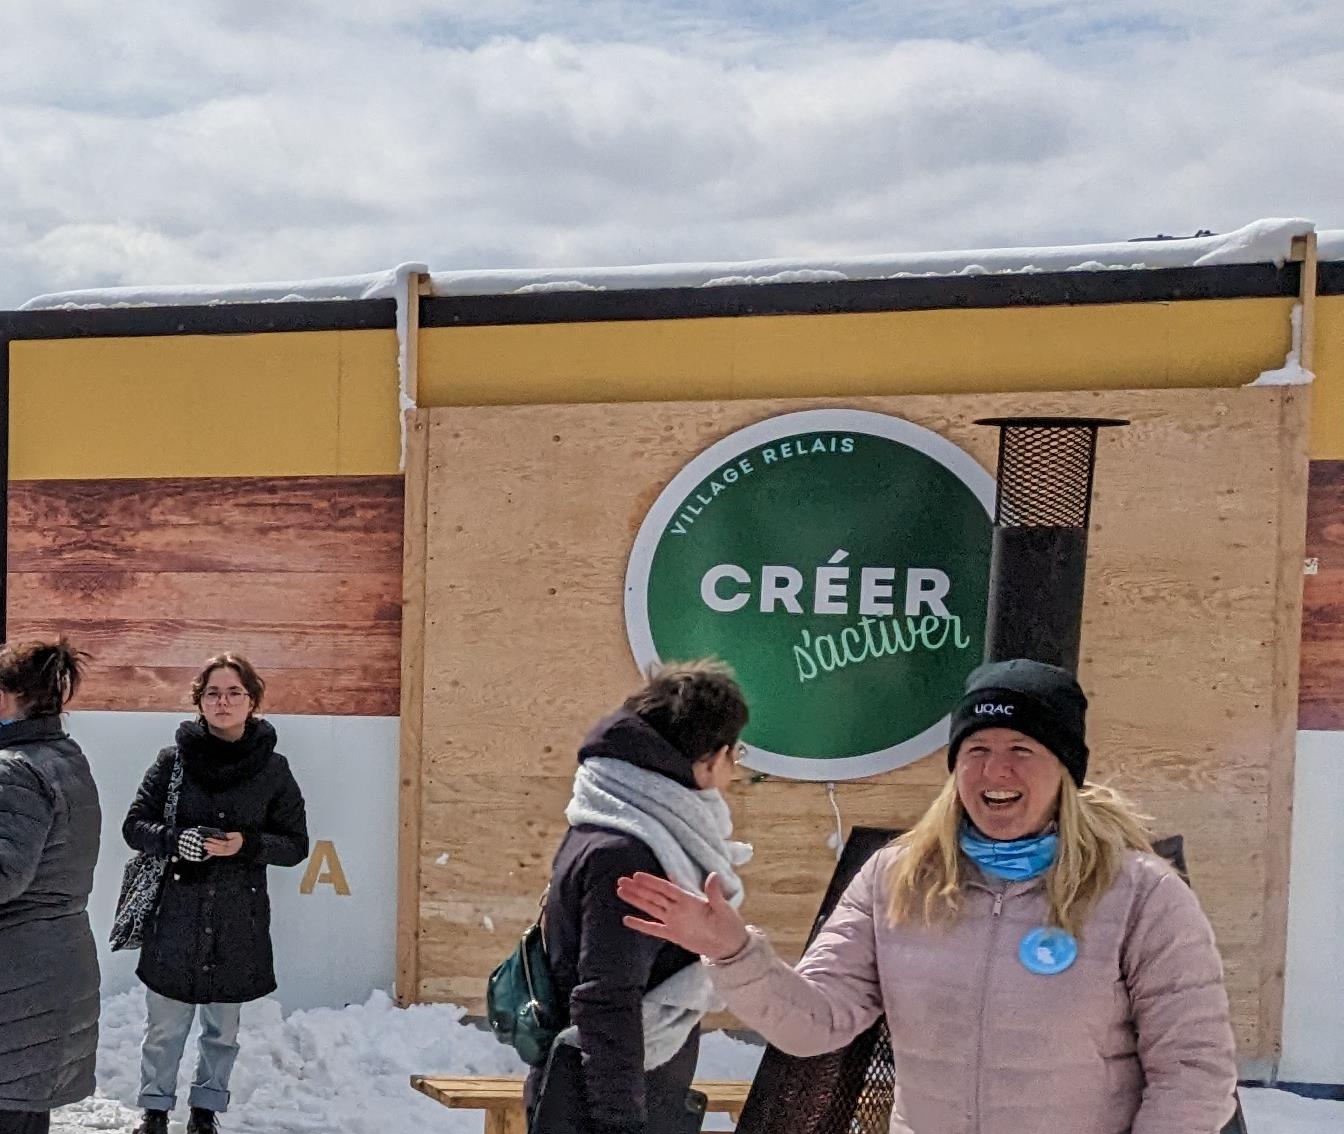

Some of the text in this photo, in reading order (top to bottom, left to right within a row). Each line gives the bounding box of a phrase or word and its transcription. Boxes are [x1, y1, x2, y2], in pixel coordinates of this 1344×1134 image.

[670, 437, 855, 536] VILLAGE RELAIS
[700, 549, 951, 620] CRÉER
[793, 610, 971, 682] s'activer
[975, 703, 1015, 715] UQAC
[299, 839, 352, 896] A
